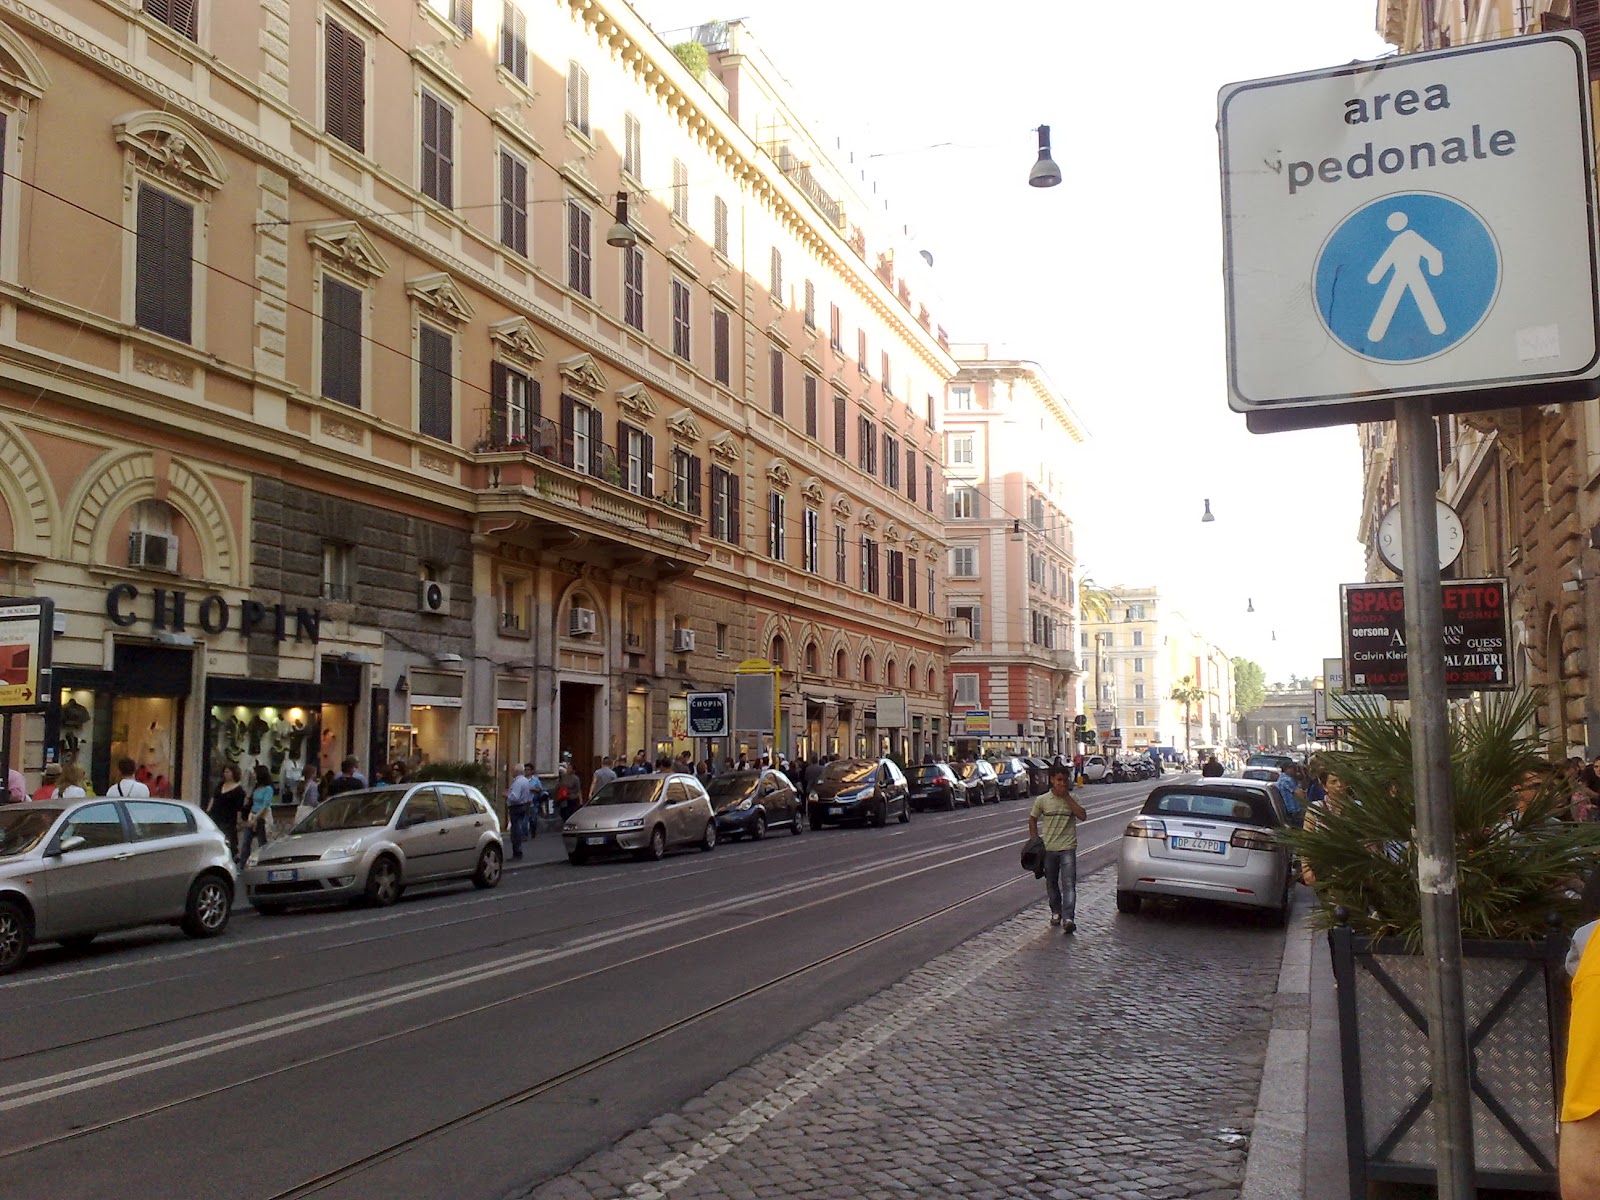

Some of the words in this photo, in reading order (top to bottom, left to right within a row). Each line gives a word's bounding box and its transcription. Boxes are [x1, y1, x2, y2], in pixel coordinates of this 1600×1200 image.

[1344, 83, 1451, 125] area
[1288, 124, 1517, 195] pedonale
[1449, 527, 1458, 539] 3
[1383, 534, 1392, 547] 9
[106, 583, 320, 645] CHOPIN
[1352, 615, 1385, 623] MODA
[1352, 627, 1389, 637] persona
[1466, 638, 1503, 648] GUESS
[1353, 651, 1384, 661] Calvin
[1463, 653, 1503, 666] ZILERI
[1178, 838, 1189, 846] DP
